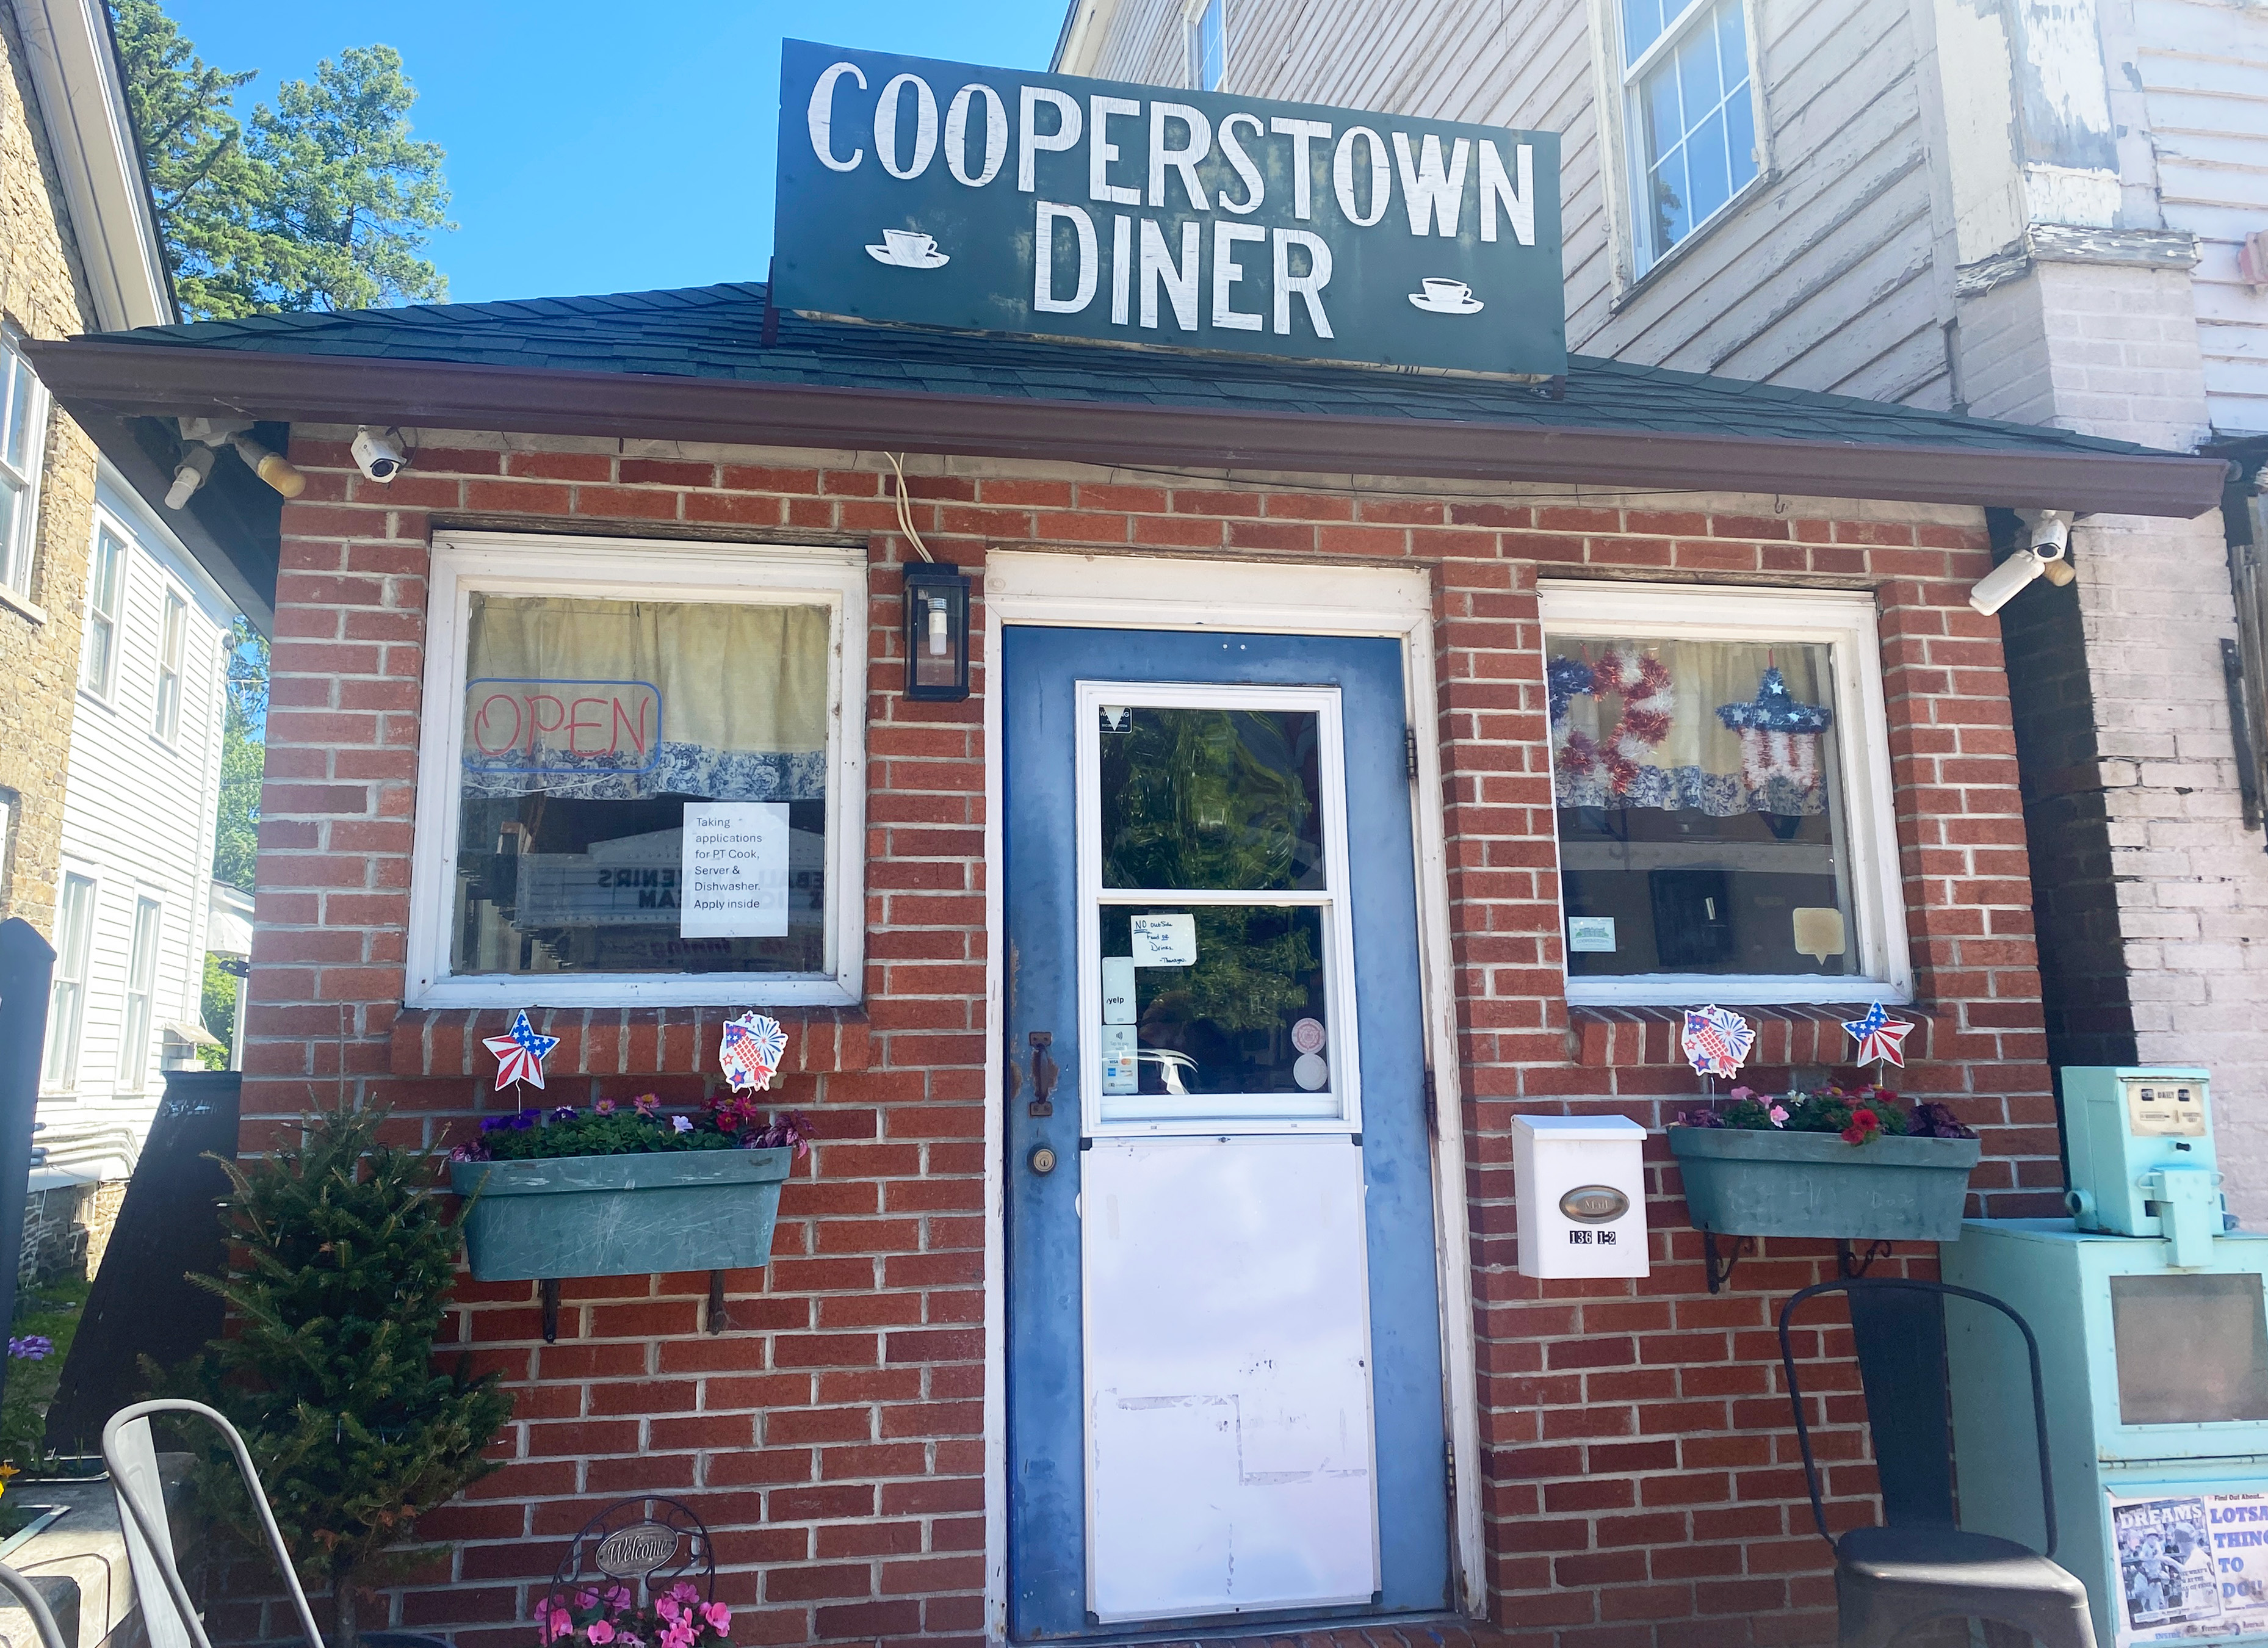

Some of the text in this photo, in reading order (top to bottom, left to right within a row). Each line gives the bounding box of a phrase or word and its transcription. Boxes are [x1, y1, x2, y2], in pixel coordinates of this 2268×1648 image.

[807, 61, 1535, 246] COOPERSTOWN
[1034, 201, 1335, 339] DINER
[474, 694, 649, 757] OPEN
[696, 817, 731, 828] Taking
[696, 834, 762, 844] applications
[695, 849, 760, 859] for PT Cook,
[695, 866, 740, 875] Server &
[695, 882, 760, 891] Dishwasher.
[693, 899, 760, 910] Apply inside
[1135, 920, 1147, 929] NO
[1108, 996, 1124, 1005] yelp
[1585, 1199, 1608, 1209] Mail
[1570, 1231, 1616, 1245] 136 1-2
[2118, 1503, 2203, 1529] DREAMS
[607, 1535, 668, 1565] Welcome
[2218, 1556, 2244, 1573] TO
